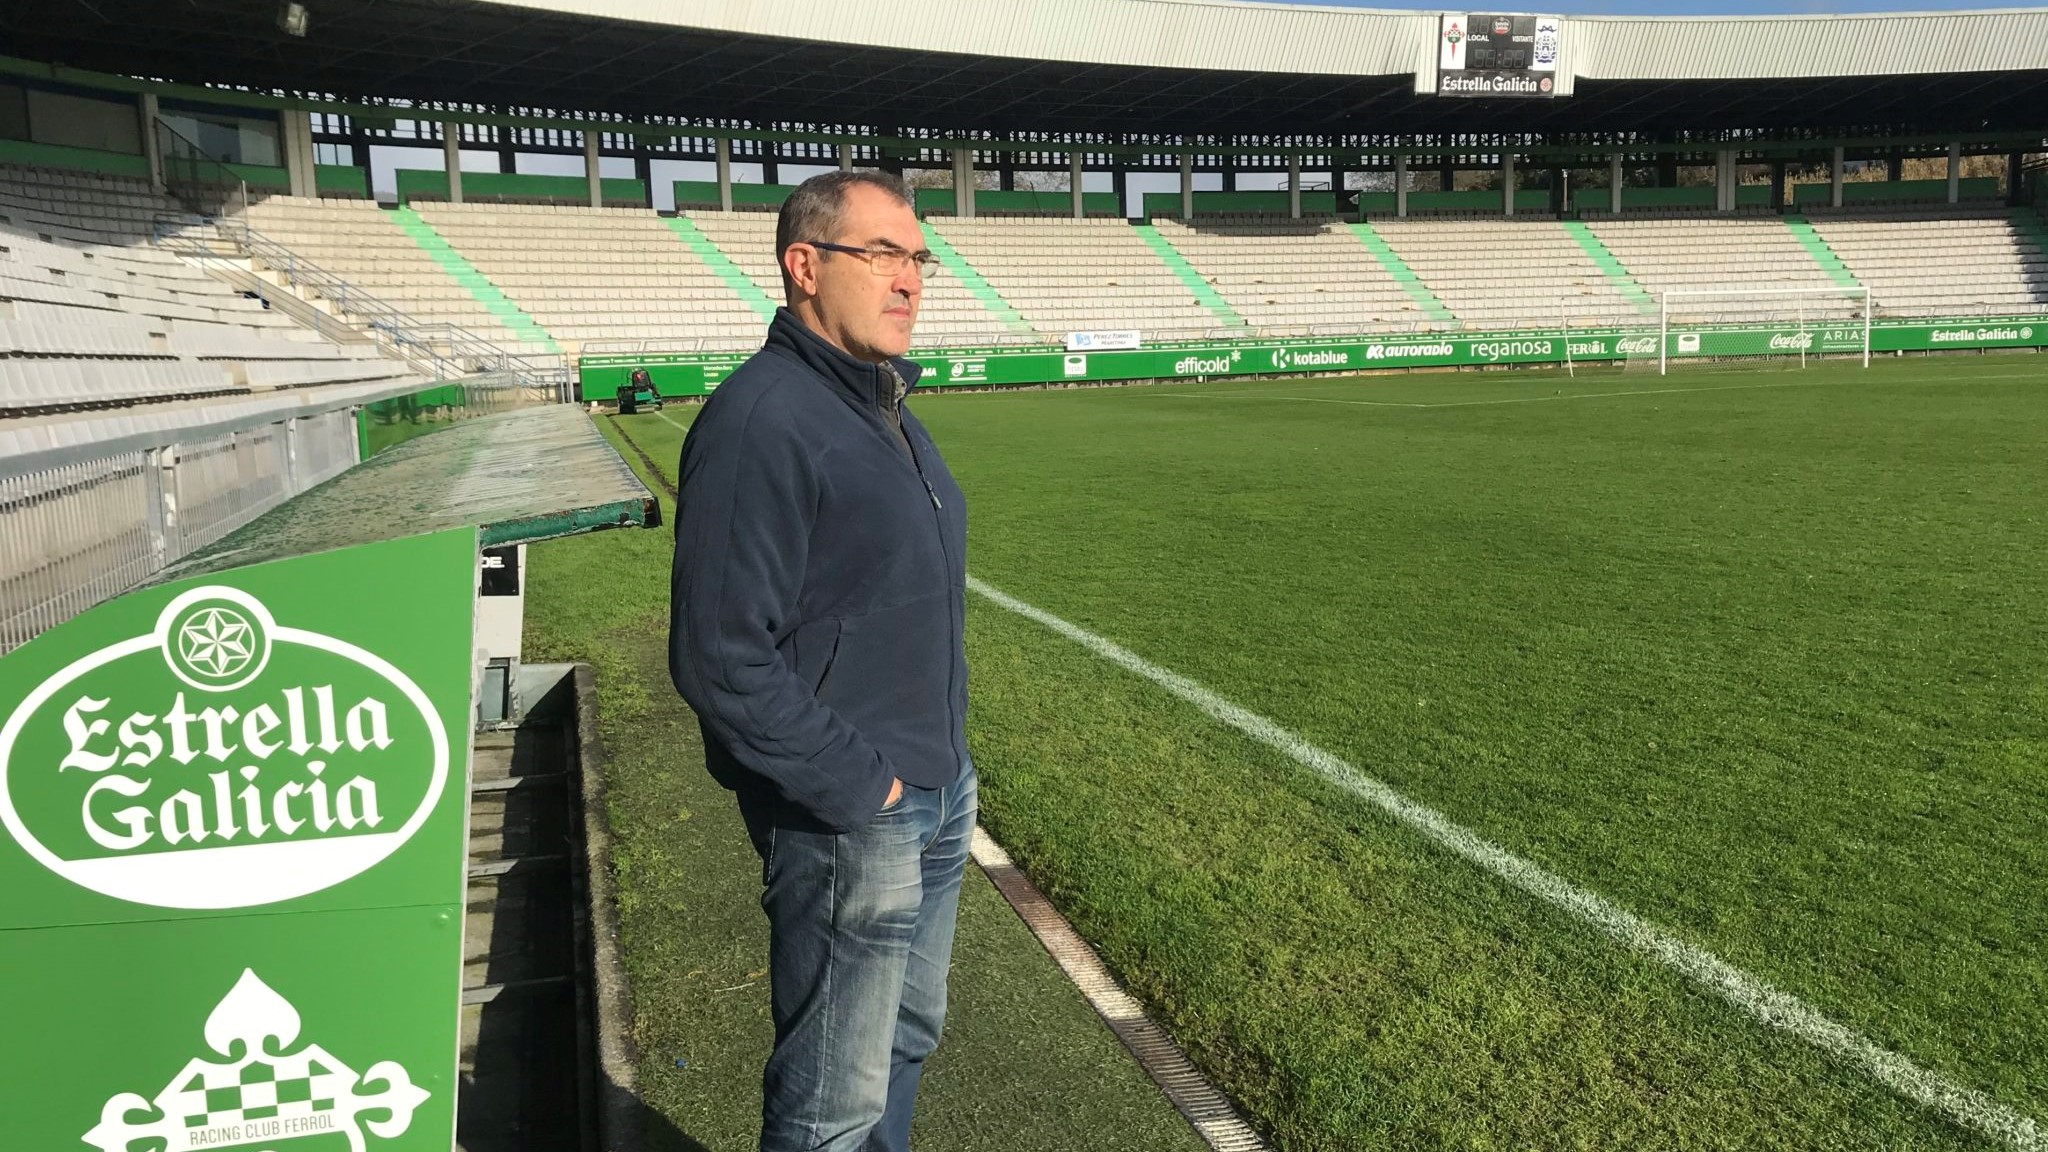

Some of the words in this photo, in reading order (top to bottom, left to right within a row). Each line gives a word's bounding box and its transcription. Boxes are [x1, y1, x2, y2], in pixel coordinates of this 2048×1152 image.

[1467, 34, 1490, 42] LOCAL
[1512, 35, 1534, 43] VISITANTE
[1442, 75, 1491, 91] Estrella
[1492, 76, 1537, 92] Galicia
[1931, 329, 1975, 342] Estrella
[1976, 328, 2018, 340] Galicia
[1294, 350, 1348, 365] kotablue
[1470, 341, 1552, 361] reganosa
[1175, 355, 1230, 374] efficold
[59, 684, 394, 773] Estrella
[82, 761, 384, 850] Galicia
[189, 1125, 241, 1146] RACING
[245, 1120, 280, 1139] CLUB
[284, 1114, 335, 1133] FERROL
